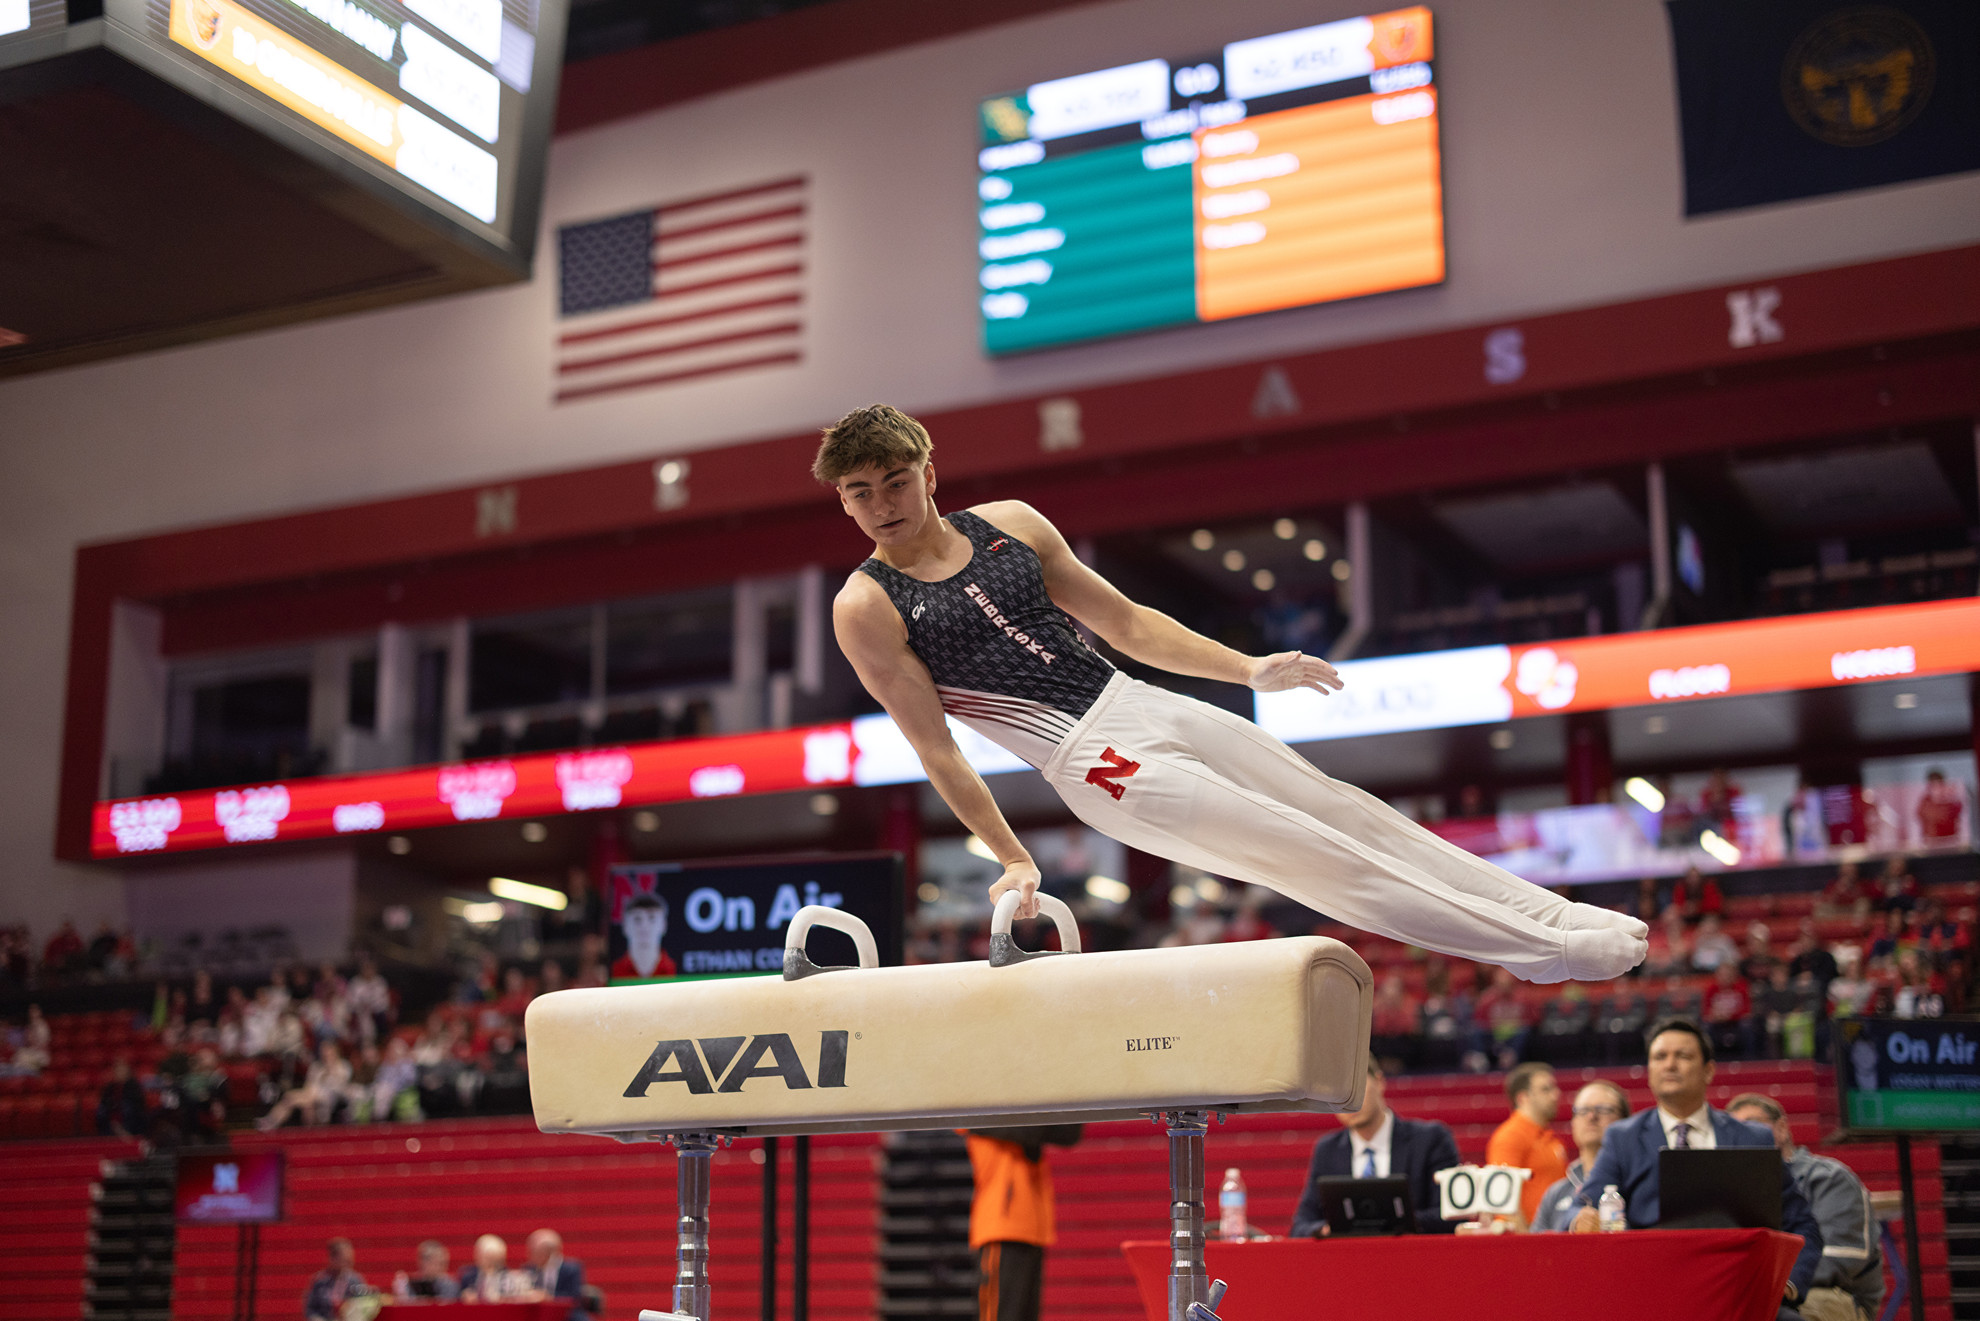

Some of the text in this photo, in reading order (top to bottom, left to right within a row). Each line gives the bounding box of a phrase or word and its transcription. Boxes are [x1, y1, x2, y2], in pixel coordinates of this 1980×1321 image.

[1727, 288, 1783, 348] K
[963, 582, 1056, 665] NEBRASKA
[1085, 746, 1141, 801] N
[684, 886, 756, 933] On
[683, 950, 752, 973] ETHAN
[1887, 1031, 1979, 1065] On Air
[1448, 1171, 1514, 1210] 00
